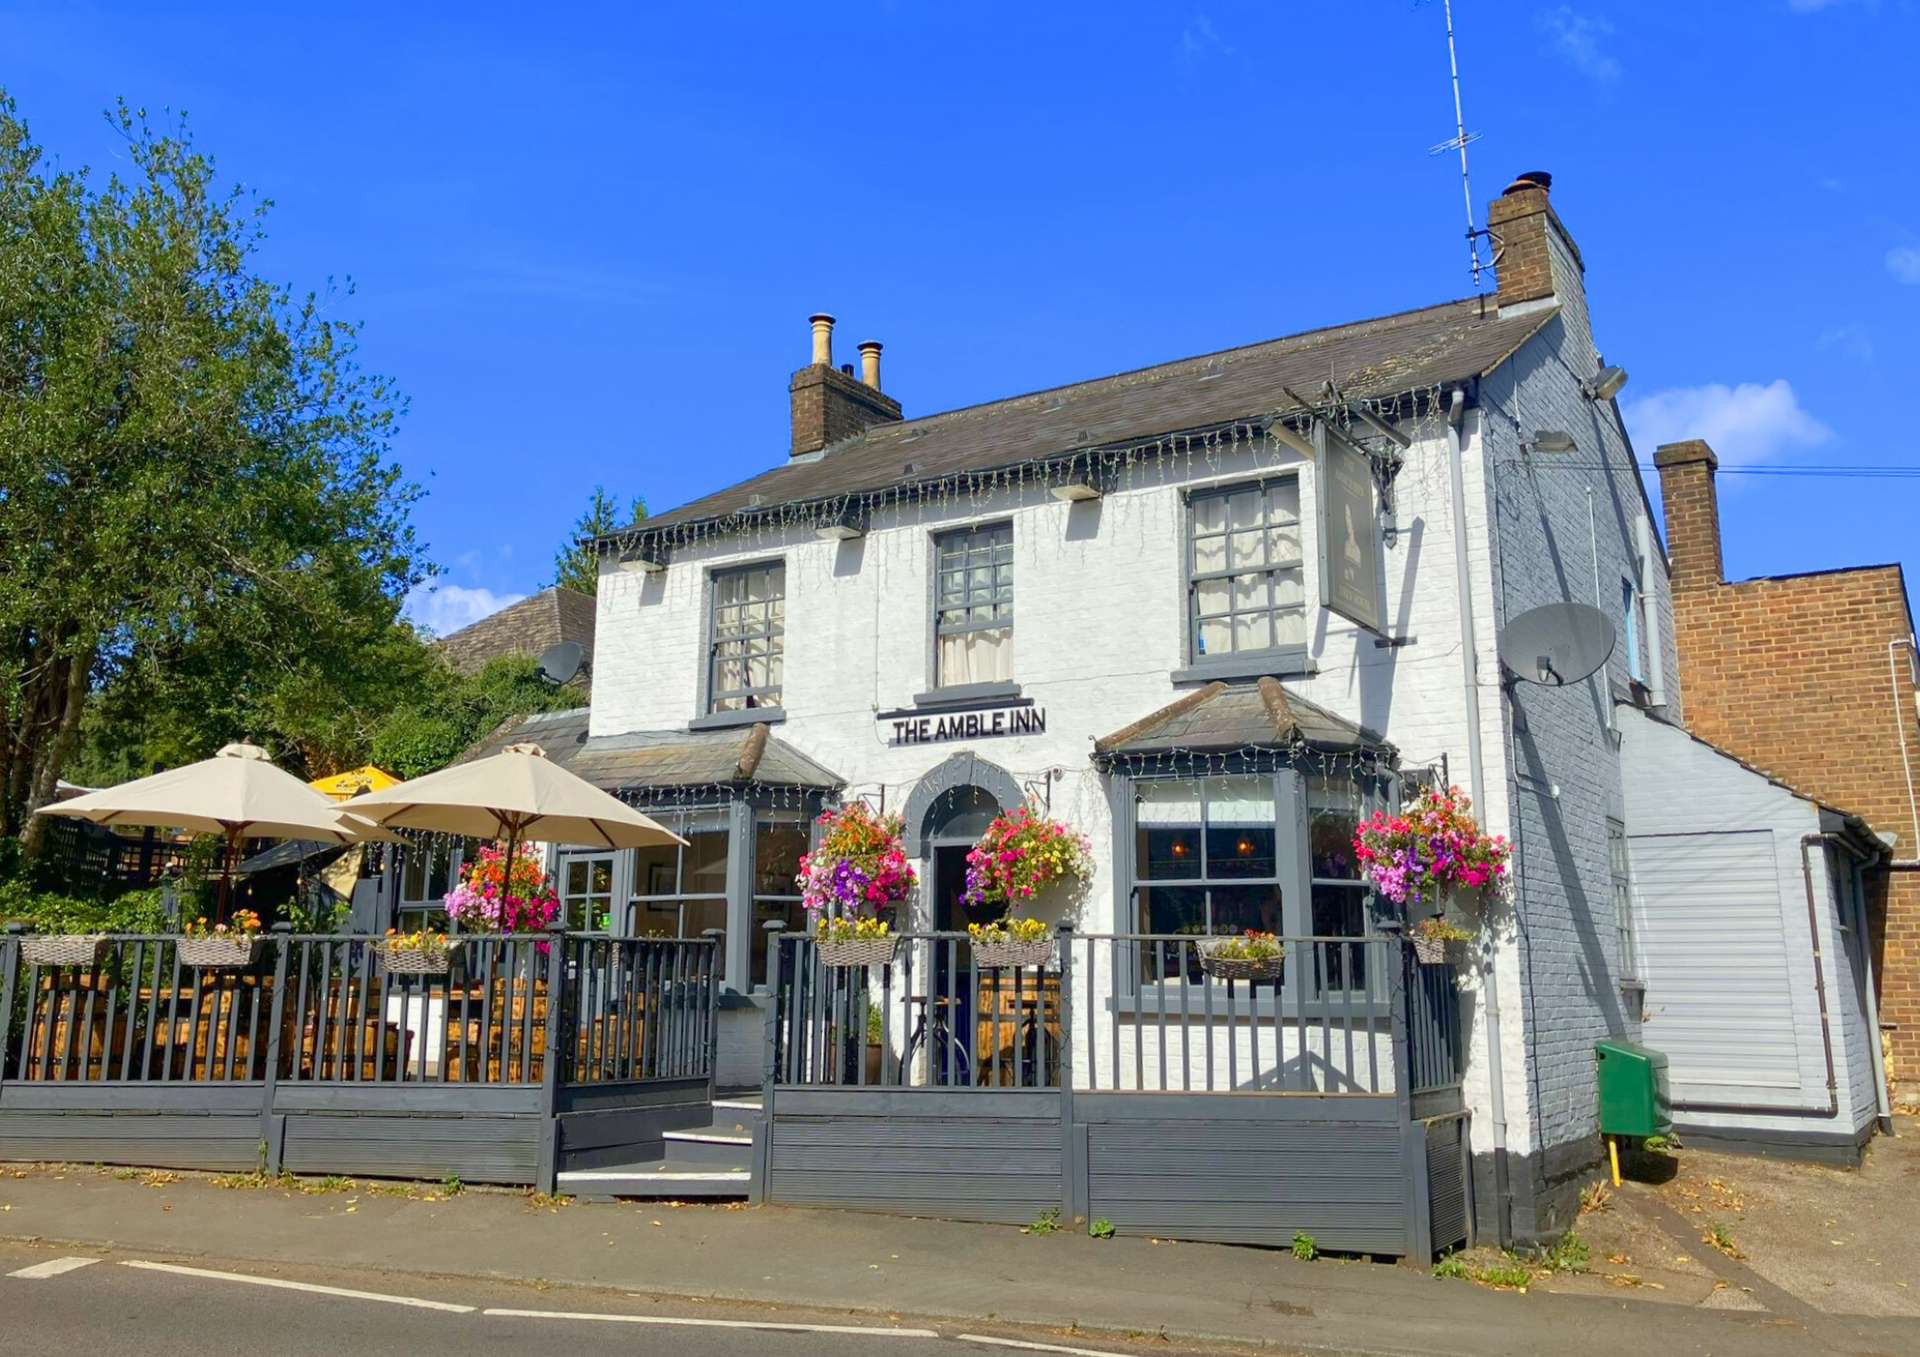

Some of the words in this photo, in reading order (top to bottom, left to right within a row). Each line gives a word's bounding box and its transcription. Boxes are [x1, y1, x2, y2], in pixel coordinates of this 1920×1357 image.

[893, 719, 930, 744] THE
[935, 712, 1004, 740] AMBLE
[1010, 708, 1046, 733] INN
